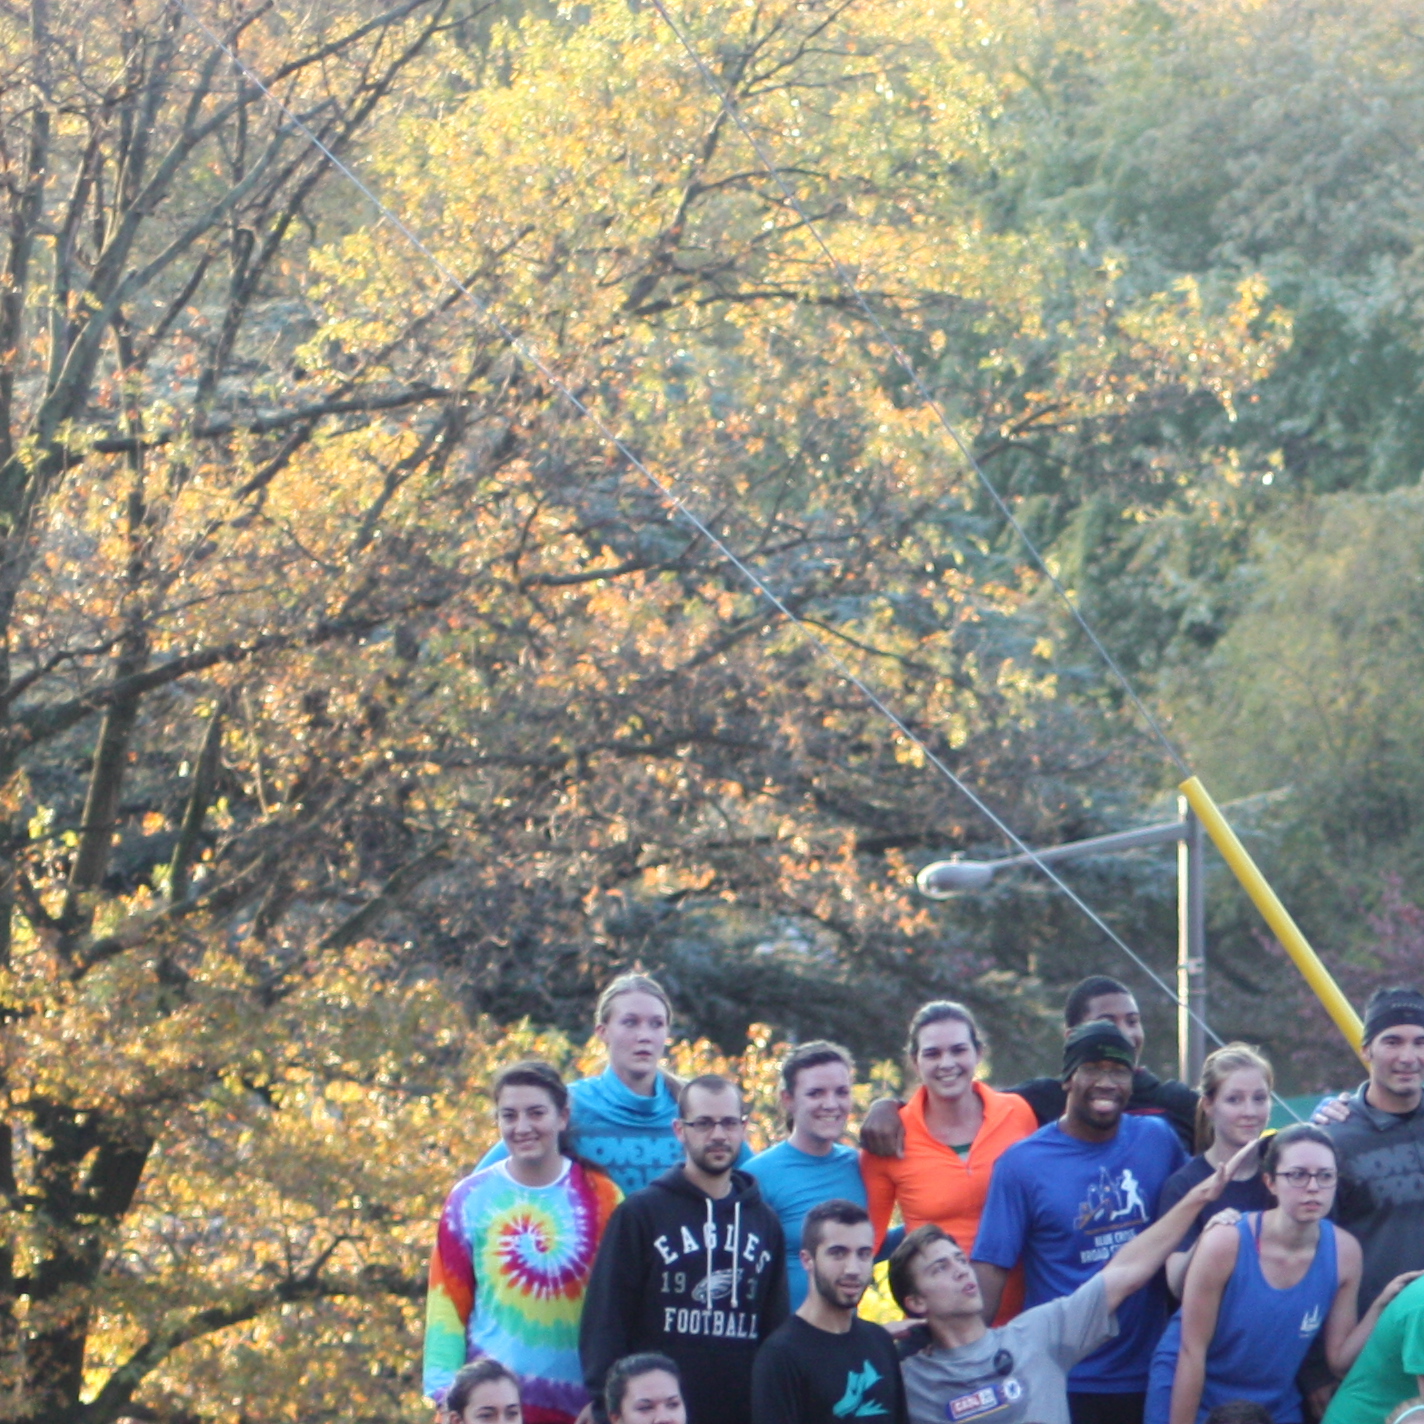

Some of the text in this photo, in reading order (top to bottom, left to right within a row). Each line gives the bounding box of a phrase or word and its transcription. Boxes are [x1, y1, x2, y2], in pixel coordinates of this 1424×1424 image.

[653, 1222, 772, 1275] EAGLES
[660, 1271, 687, 1294] 19
[663, 1307, 759, 1339] FOOTBALL
